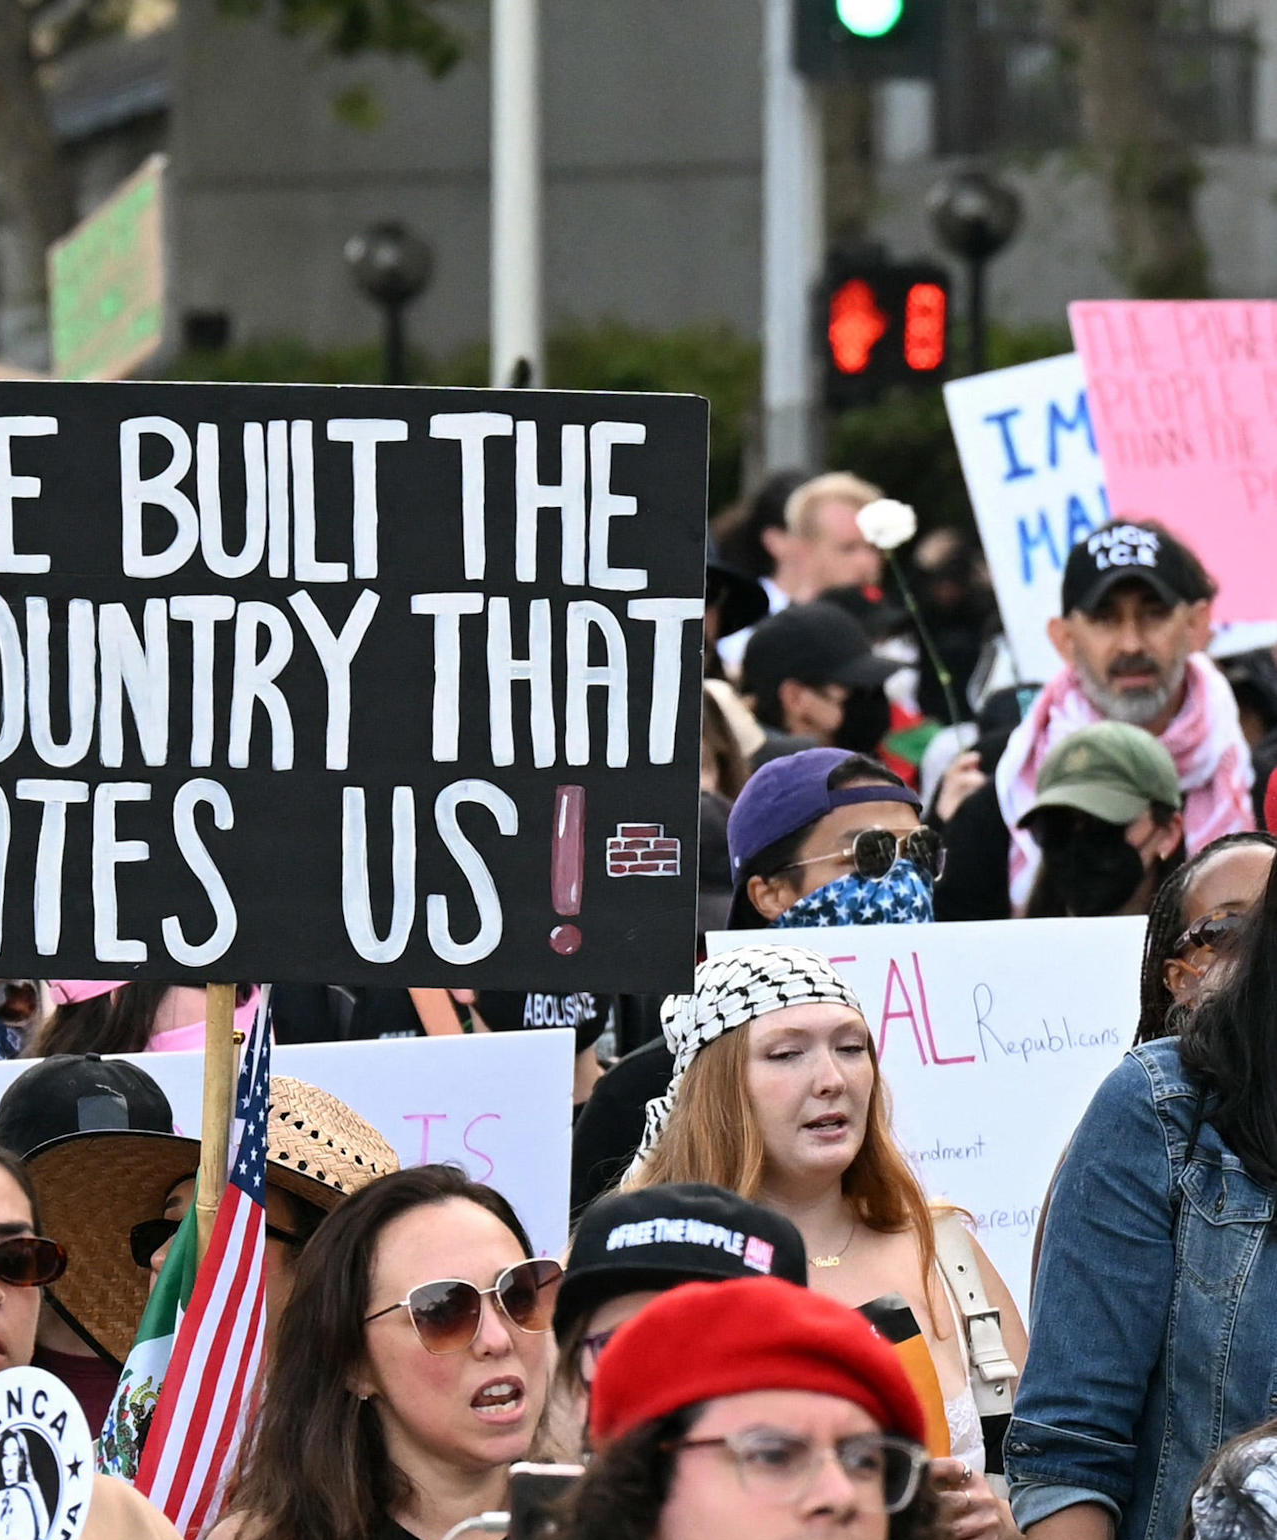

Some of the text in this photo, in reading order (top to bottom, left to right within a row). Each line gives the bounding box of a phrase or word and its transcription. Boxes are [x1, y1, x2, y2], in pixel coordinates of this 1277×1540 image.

[118, 415, 409, 583] BUILT
[429, 411, 648, 592] THE
[410, 591, 706, 770] THAT
[972, 982, 1124, 1064] Republicans
